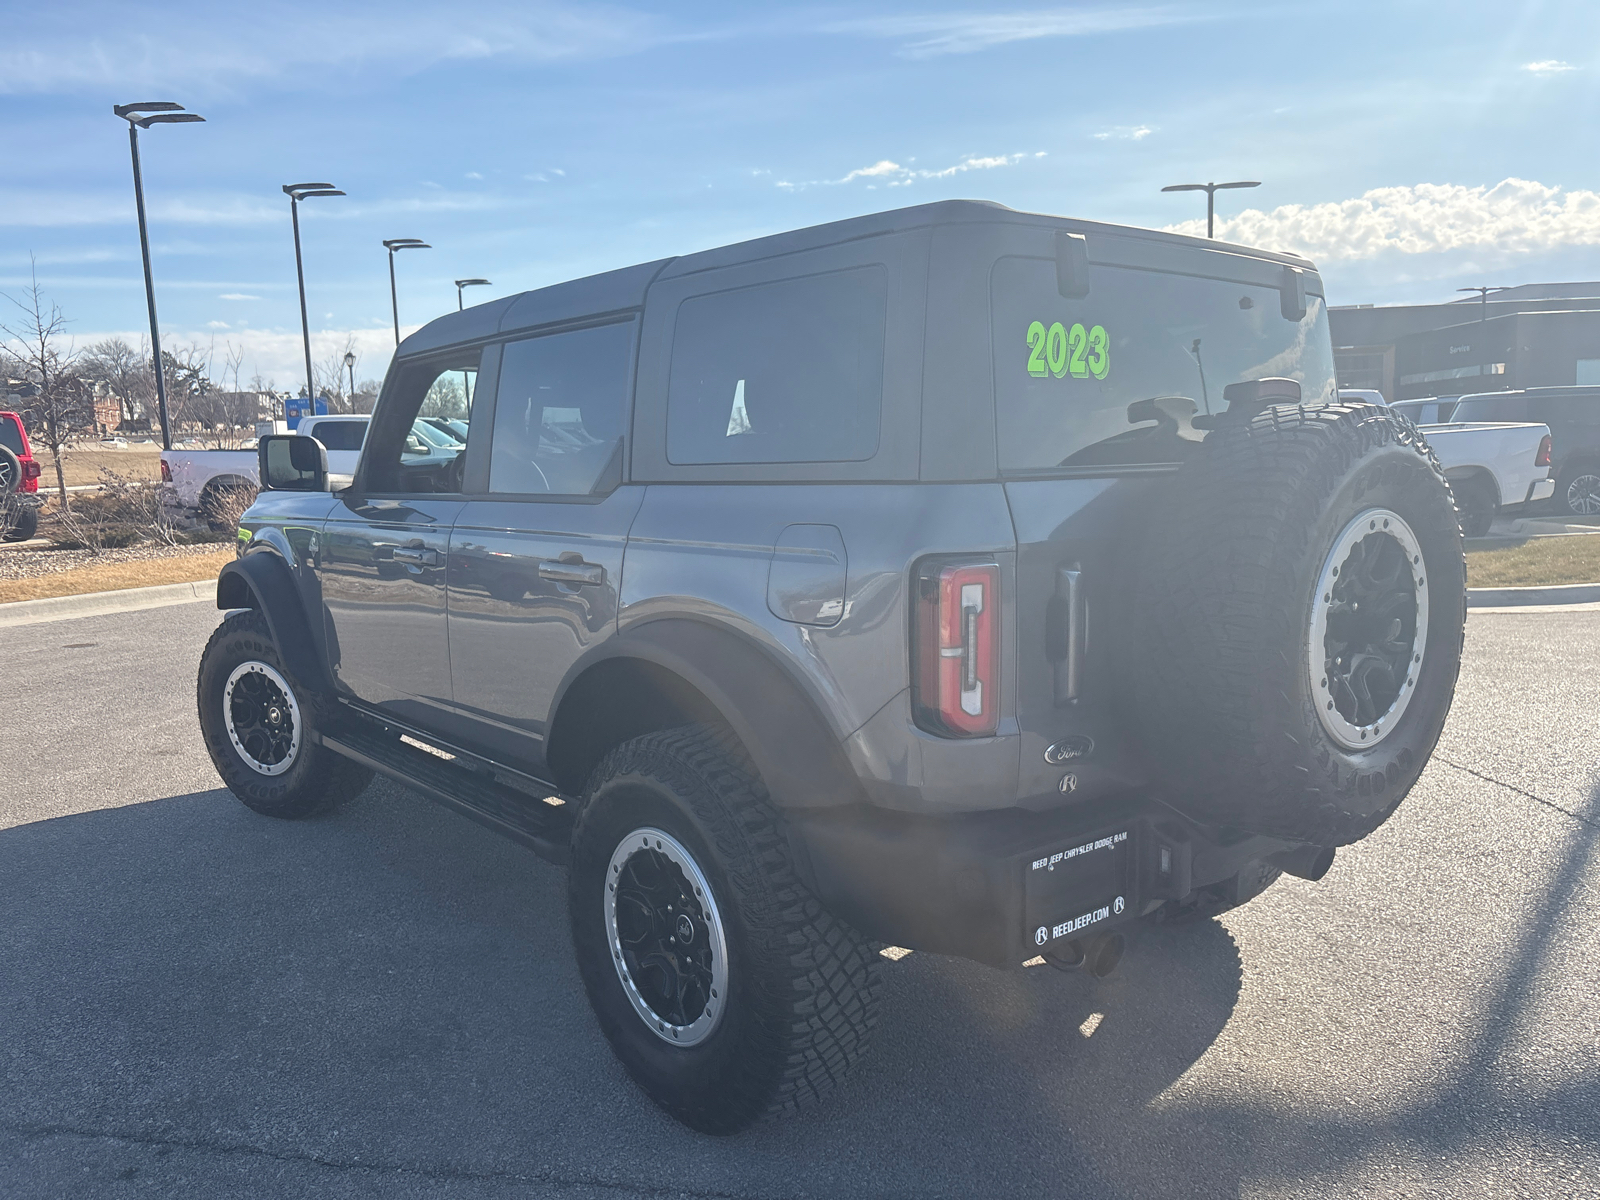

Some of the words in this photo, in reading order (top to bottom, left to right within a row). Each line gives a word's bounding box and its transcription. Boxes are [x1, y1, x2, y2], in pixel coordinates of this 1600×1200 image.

[1026, 320, 1110, 380] 2023
[1449, 344, 1471, 354] Service
[1057, 746, 1083, 760] Ford
[1032, 857, 1048, 870] REED
[1049, 852, 1063, 865] JEEP
[1064, 842, 1094, 860] CHRYSLER
[1094, 836, 1114, 850] DODGE
[1113, 831, 1128, 844] RAM
[1052, 906, 1110, 939] REEDJEEP.COM
